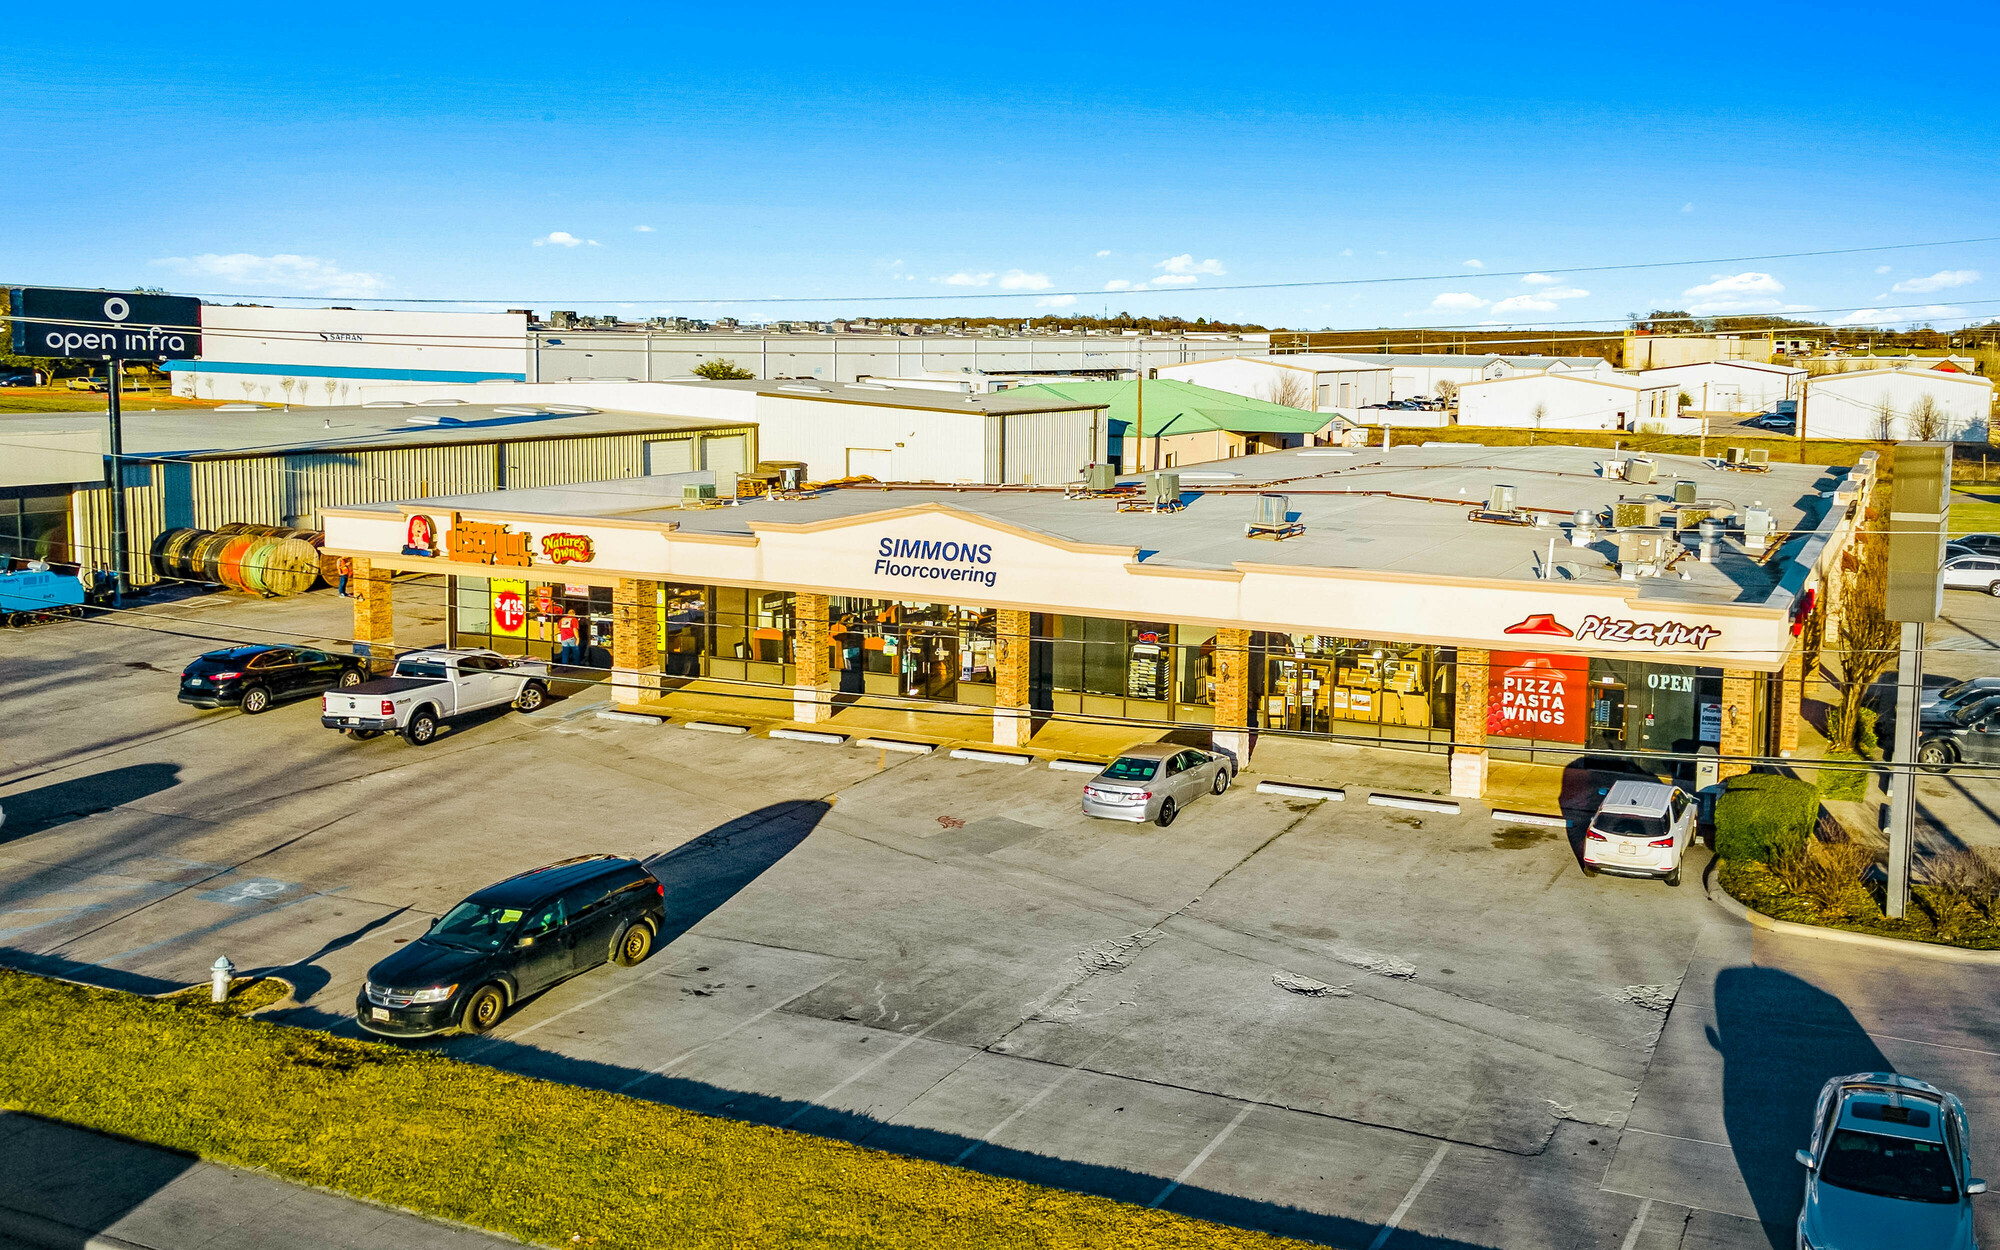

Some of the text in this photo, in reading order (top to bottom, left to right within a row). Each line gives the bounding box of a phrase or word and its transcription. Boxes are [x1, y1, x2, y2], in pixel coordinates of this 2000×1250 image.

[46, 326, 185, 356] open infra
[330, 333, 363, 341] SAFRAN
[543, 534, 586, 554] Nature's
[878, 537, 992, 564] SIMMONS
[553, 547, 578, 563] Own
[874, 559, 997, 587] Floorcovering
[1576, 615, 1722, 650] Pizza Hut
[1503, 677, 1565, 695] PIZZA
[1648, 674, 1694, 693] OPEN
[1503, 692, 1565, 710] PASTA
[1502, 706, 1565, 725] WINGS
